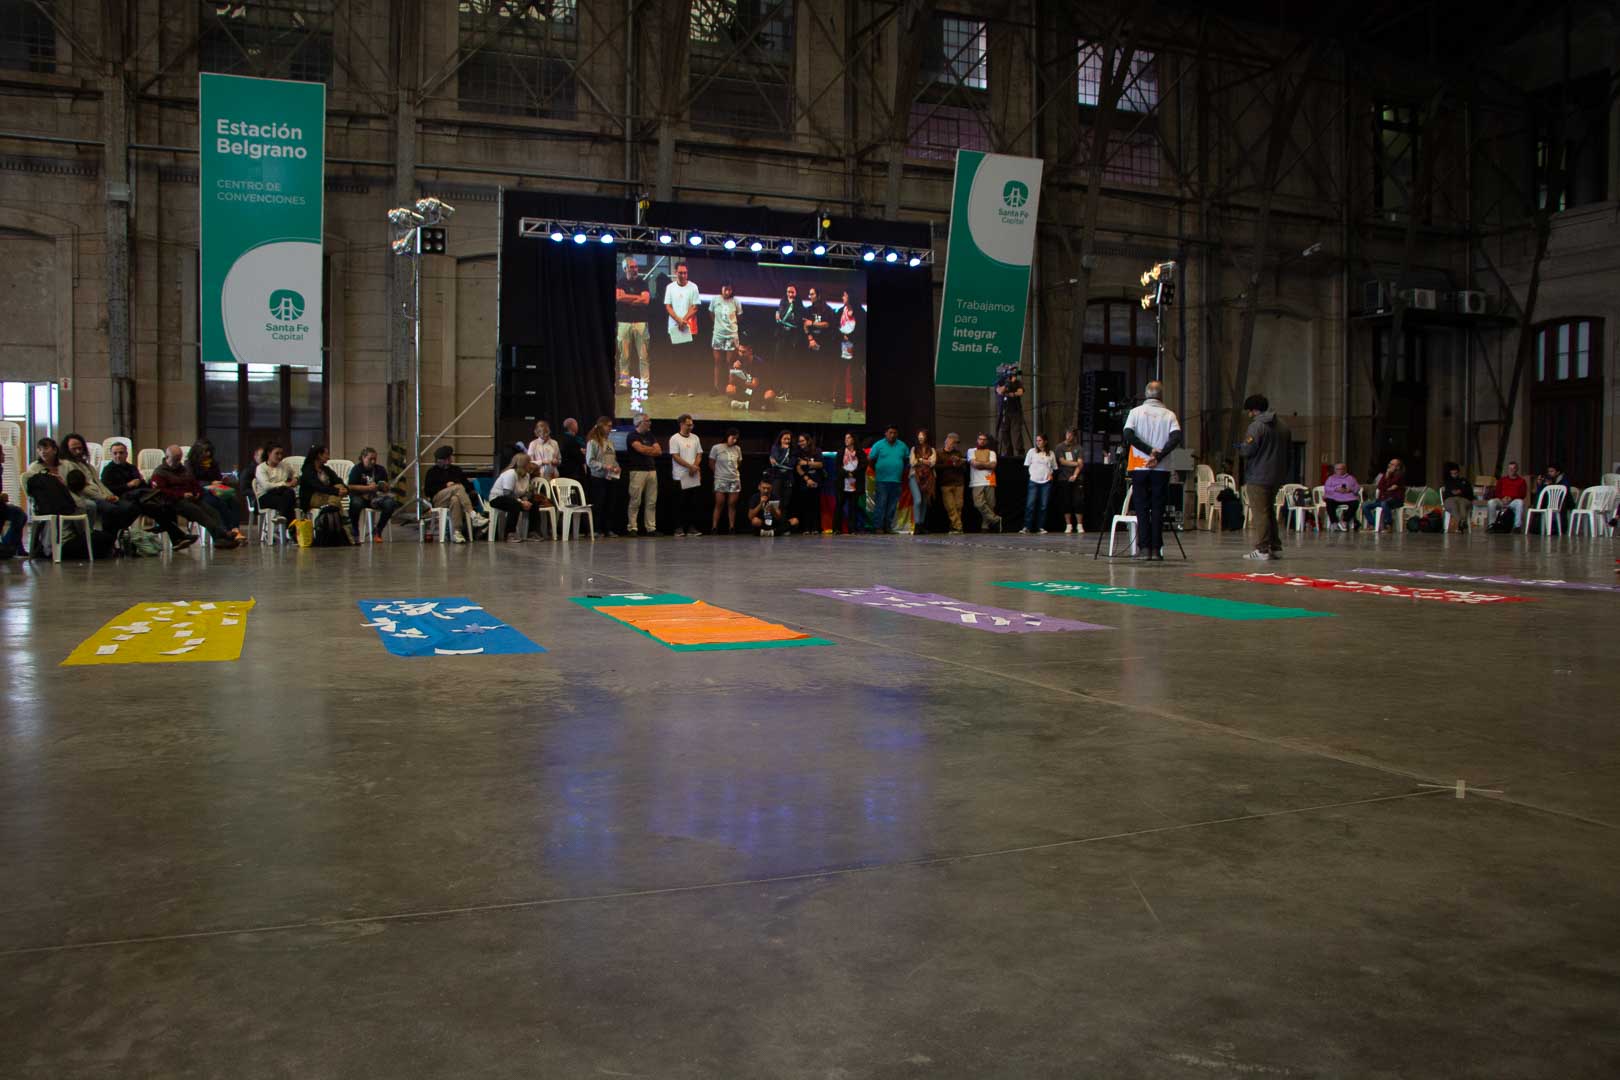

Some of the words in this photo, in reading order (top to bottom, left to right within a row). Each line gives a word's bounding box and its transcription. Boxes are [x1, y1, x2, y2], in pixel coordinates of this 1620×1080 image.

[216, 119, 303, 140] Estación
[216, 138, 307, 160] Belgrano
[217, 179, 263, 191] CENTRO
[266, 182, 281, 192] DE
[217, 192, 305, 205] CONVENCIONES
[998, 208, 1018, 217] Santa
[1001, 217, 1024, 225] Capital
[956, 299, 1015, 313] Trabajamos
[954, 315, 978, 324] para
[265, 323, 294, 333] Santa
[297, 324, 309, 333] Fe
[953, 327, 997, 340] integrar
[271, 332, 304, 342] Capital
[952, 341, 982, 353] Santa
[985, 343, 1001, 354] Fe.
